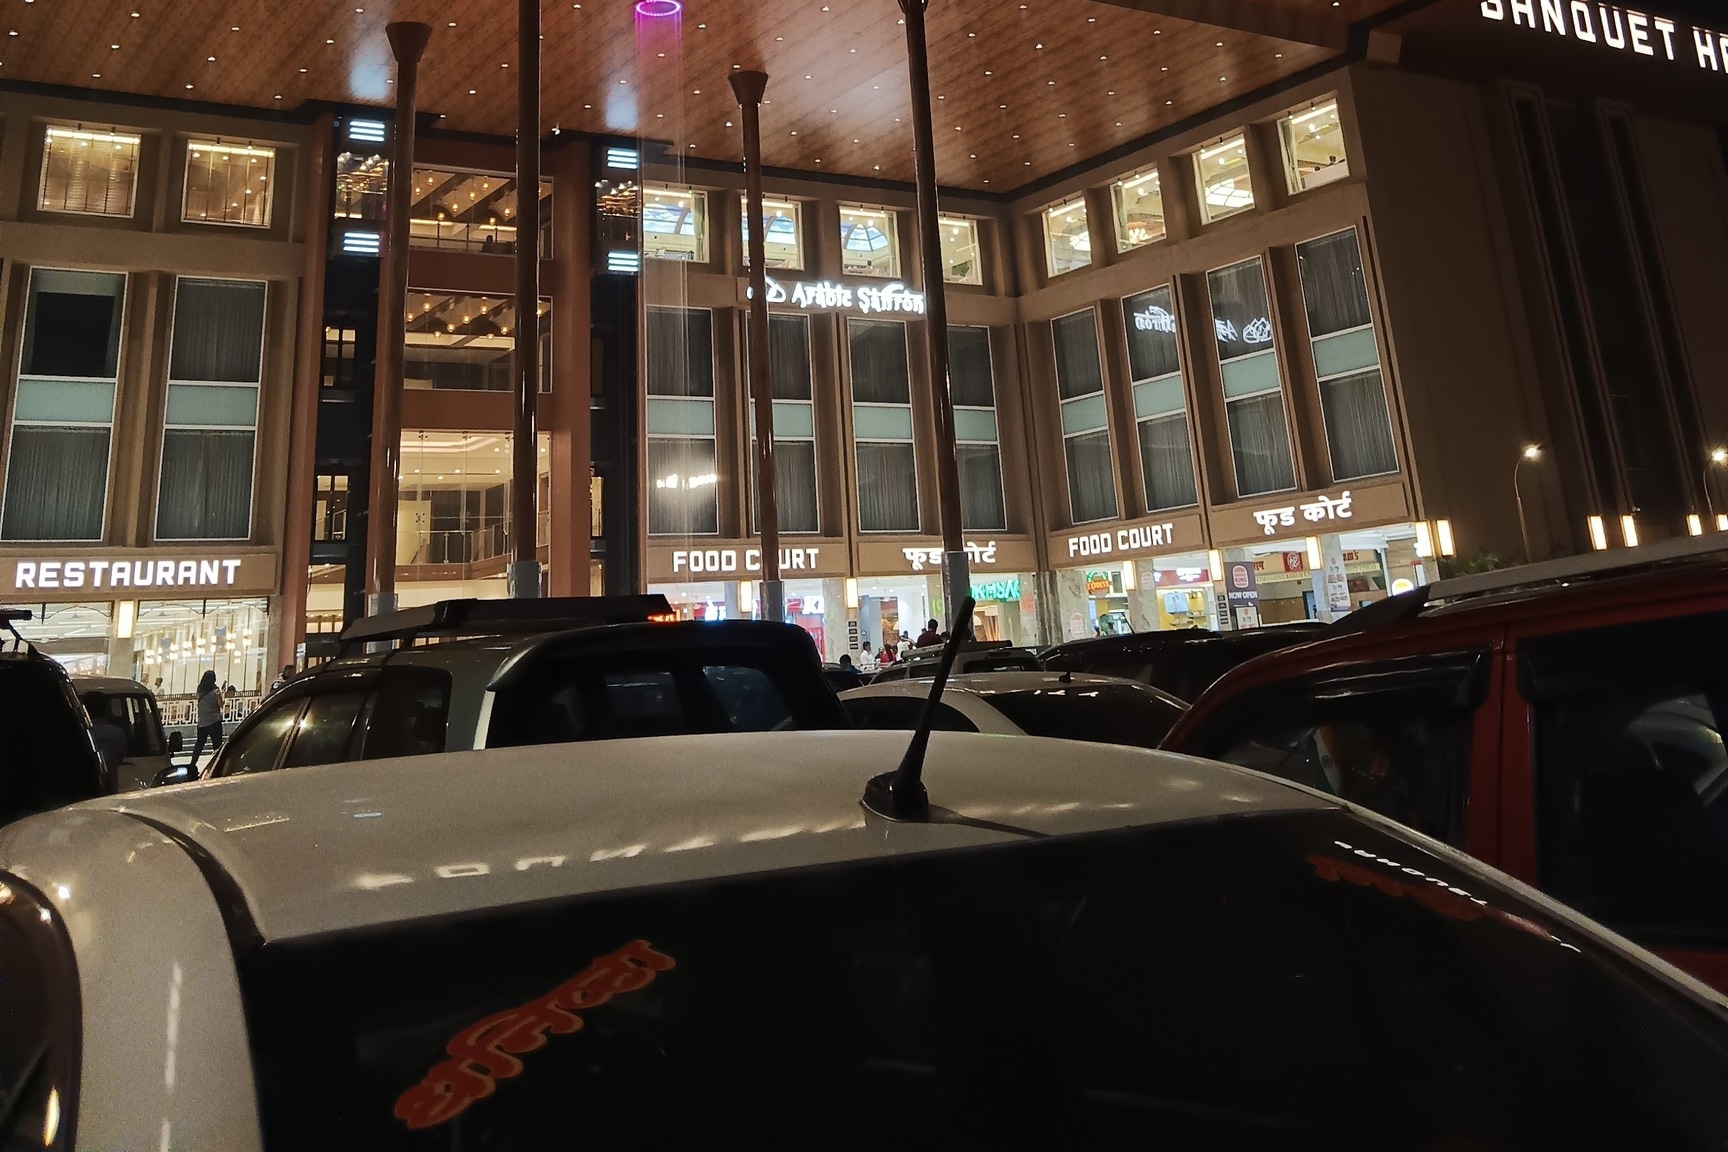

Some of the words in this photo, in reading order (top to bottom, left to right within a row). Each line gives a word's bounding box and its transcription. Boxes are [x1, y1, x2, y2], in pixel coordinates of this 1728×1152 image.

[792, 281, 852, 309] Arabic
[857, 282, 925, 315] Saffron
[1253, 506, 1296, 535] फूड
[1299, 490, 1352, 522] कोर्ट
[1068, 532, 1112, 558] FOOD
[1117, 523, 1173, 550] COURT
[673, 549, 737, 573] FOOD
[745, 548, 819, 571] CURT
[902, 547, 944, 570] फूड
[963, 541, 997, 564] ोर्ट
[15, 559, 242, 588] RESTAURANT
[1242, 590, 1258, 599] OPEN
